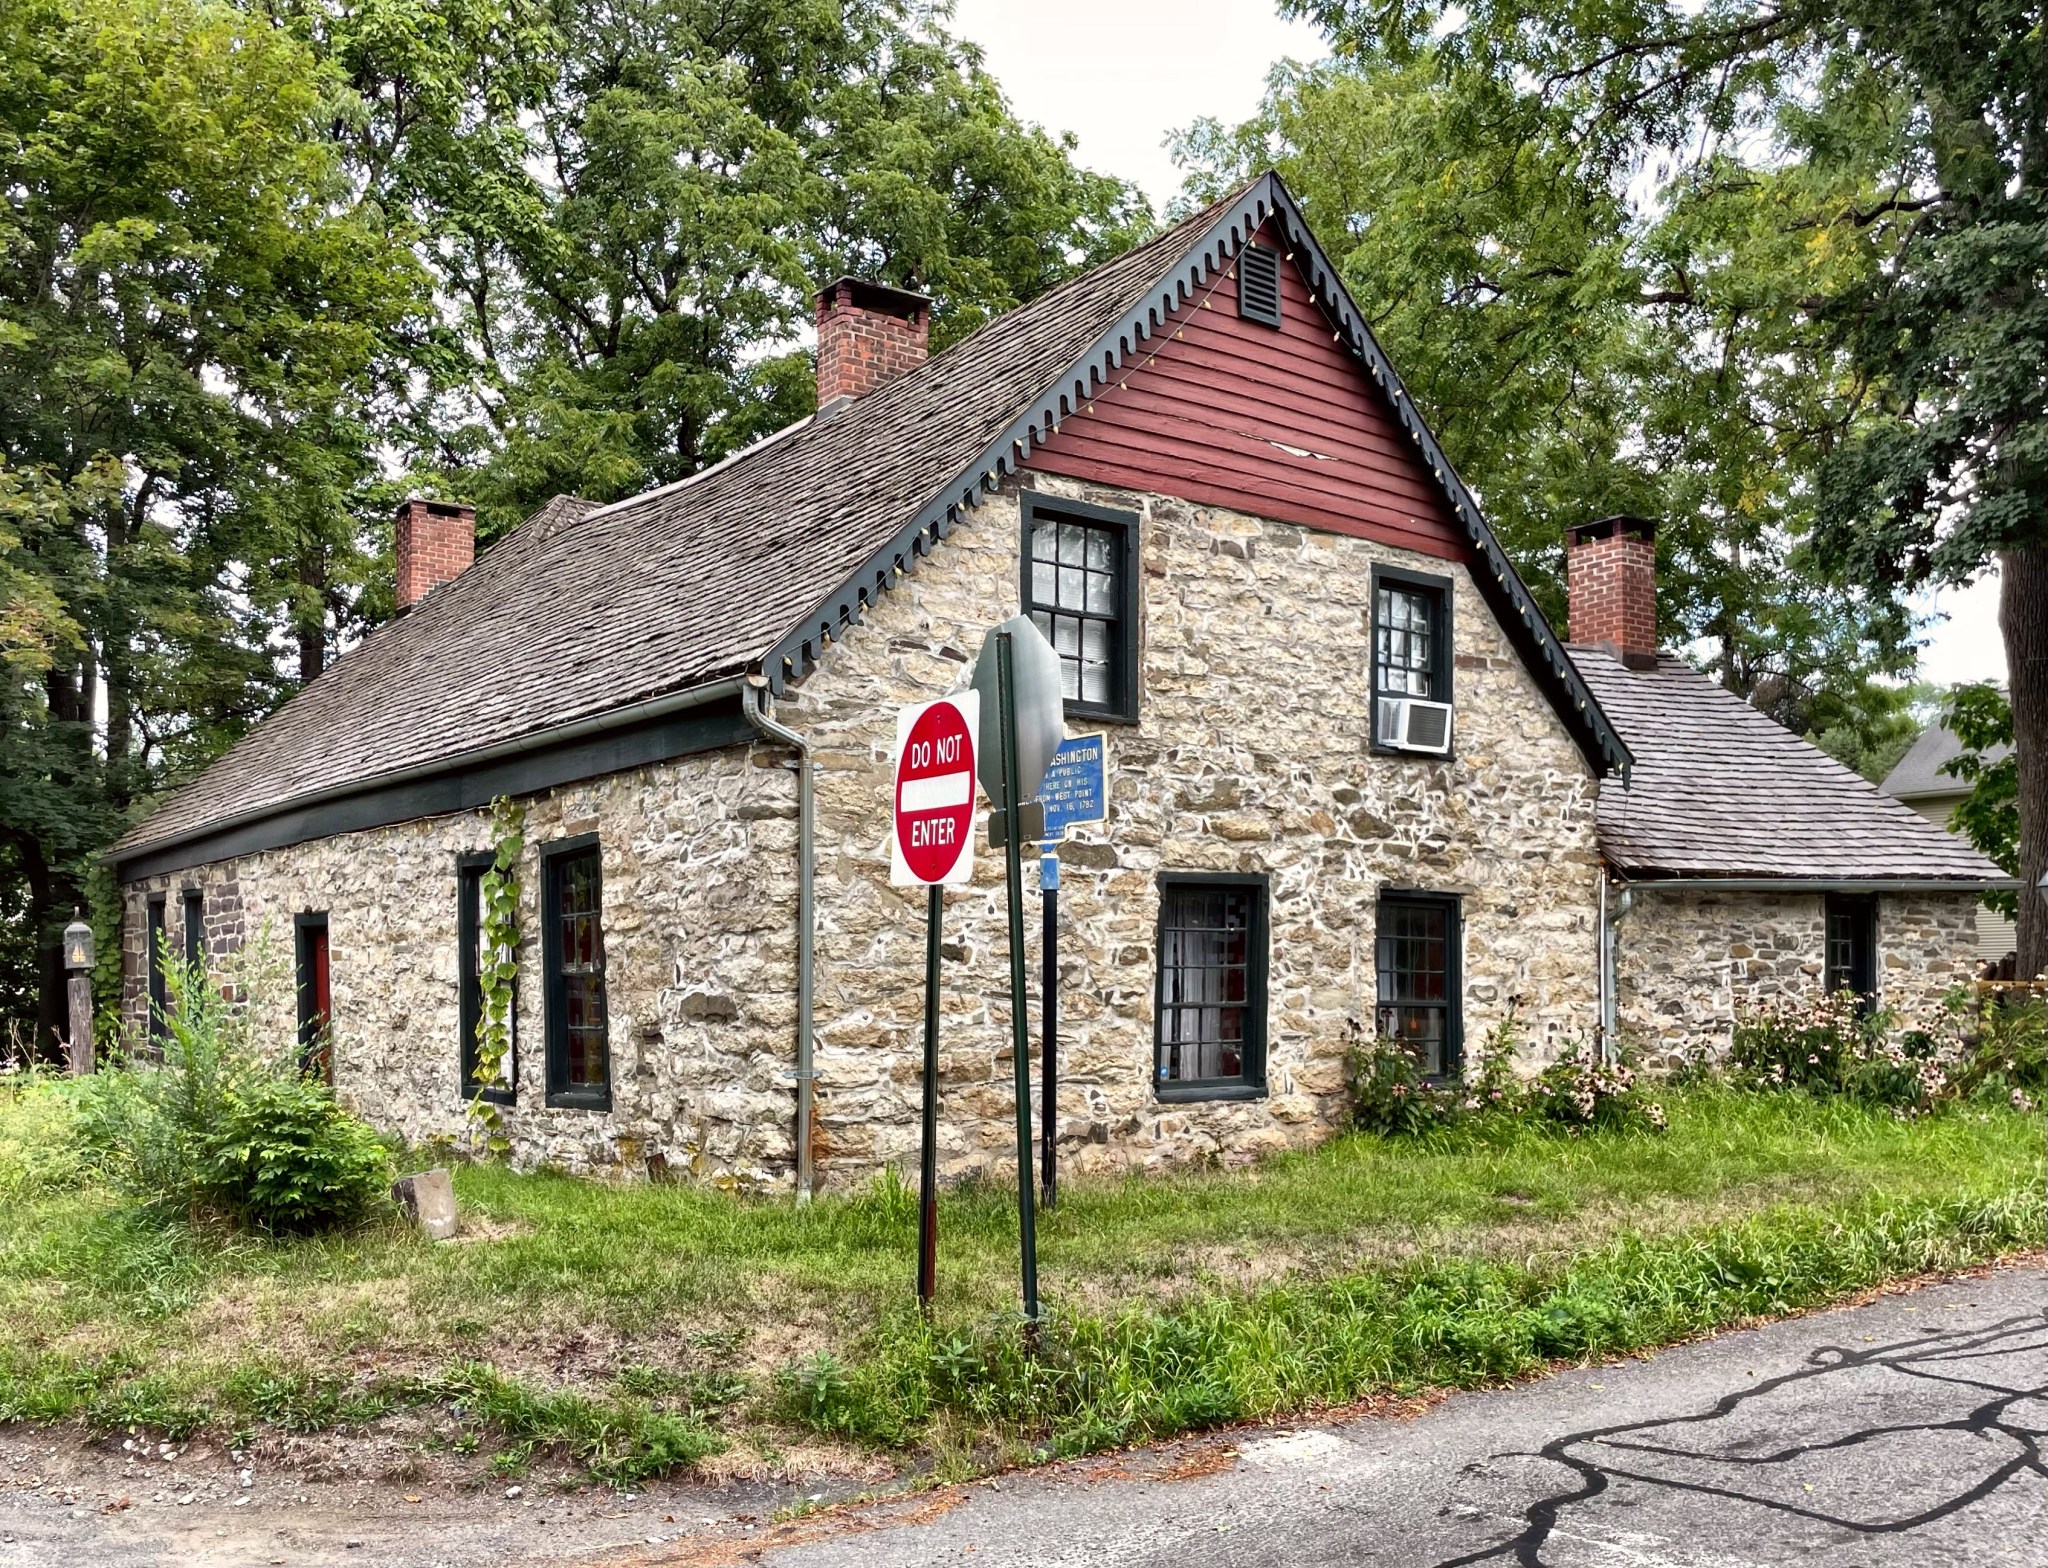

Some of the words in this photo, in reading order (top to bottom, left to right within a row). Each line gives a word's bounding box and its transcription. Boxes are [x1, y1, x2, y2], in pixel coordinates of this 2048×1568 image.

[911, 741, 931, 769] DO
[936, 734, 963, 765] NOT
[1051, 747, 1097, 766] ASHINGTON
[1059, 766, 1081, 776] PUBLIC
[1077, 777, 1087, 786] HIS
[1055, 791, 1070, 801] WEST
[1075, 788, 1092, 798] POINT
[912, 817, 955, 847] ENTER
